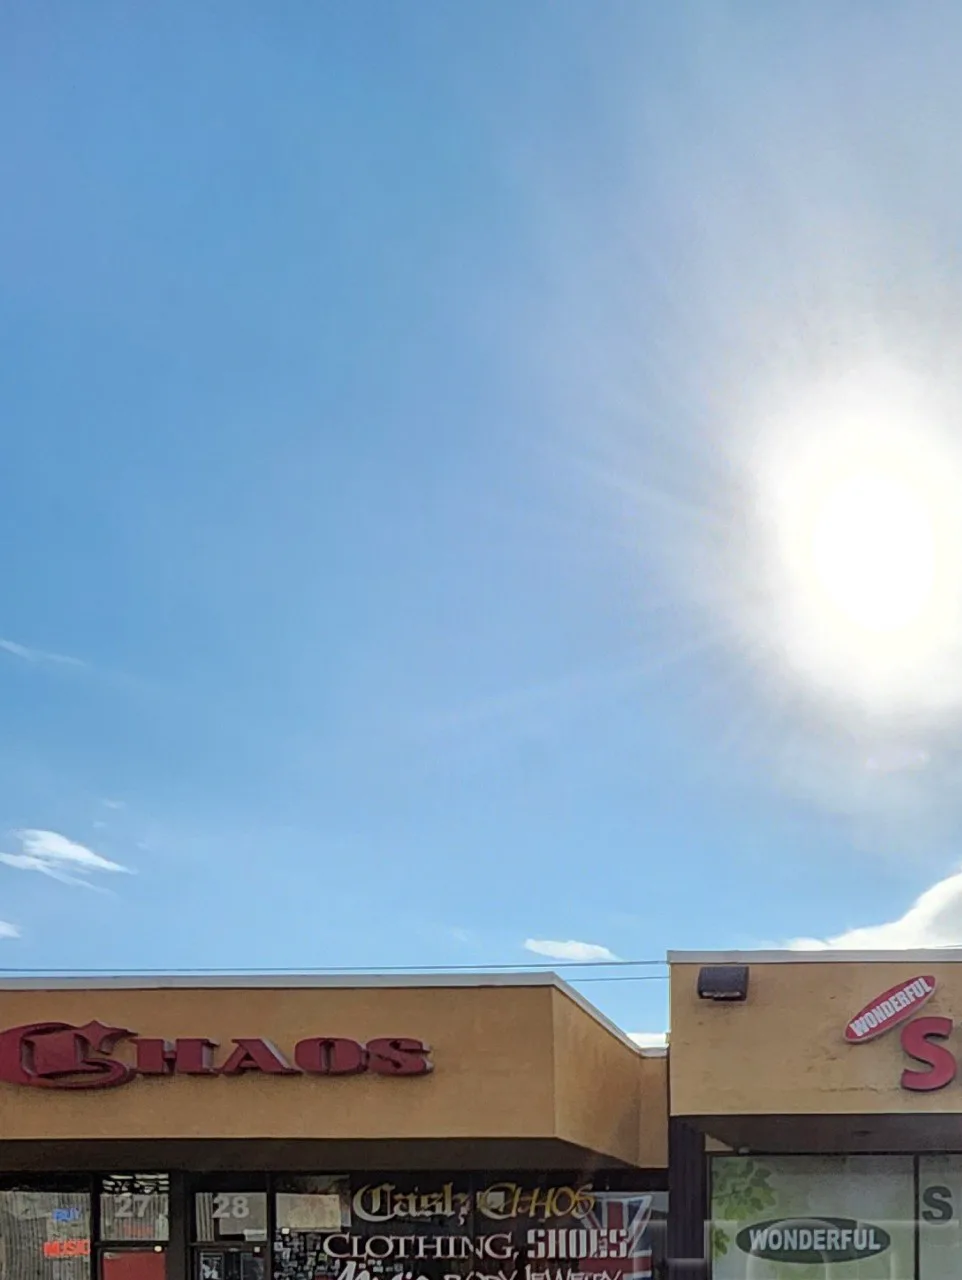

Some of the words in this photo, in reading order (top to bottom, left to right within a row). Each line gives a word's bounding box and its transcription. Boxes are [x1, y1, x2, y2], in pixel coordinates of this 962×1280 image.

[849, 976, 933, 1038] WONDERFUL
[114, 1194, 151, 1218] 27
[211, 1195, 250, 1219] 28
[322, 1233, 519, 1261] CLOTHING,
[526, 1228, 637, 1259] SHOES
[747, 1228, 882, 1253] WONDERFUL
